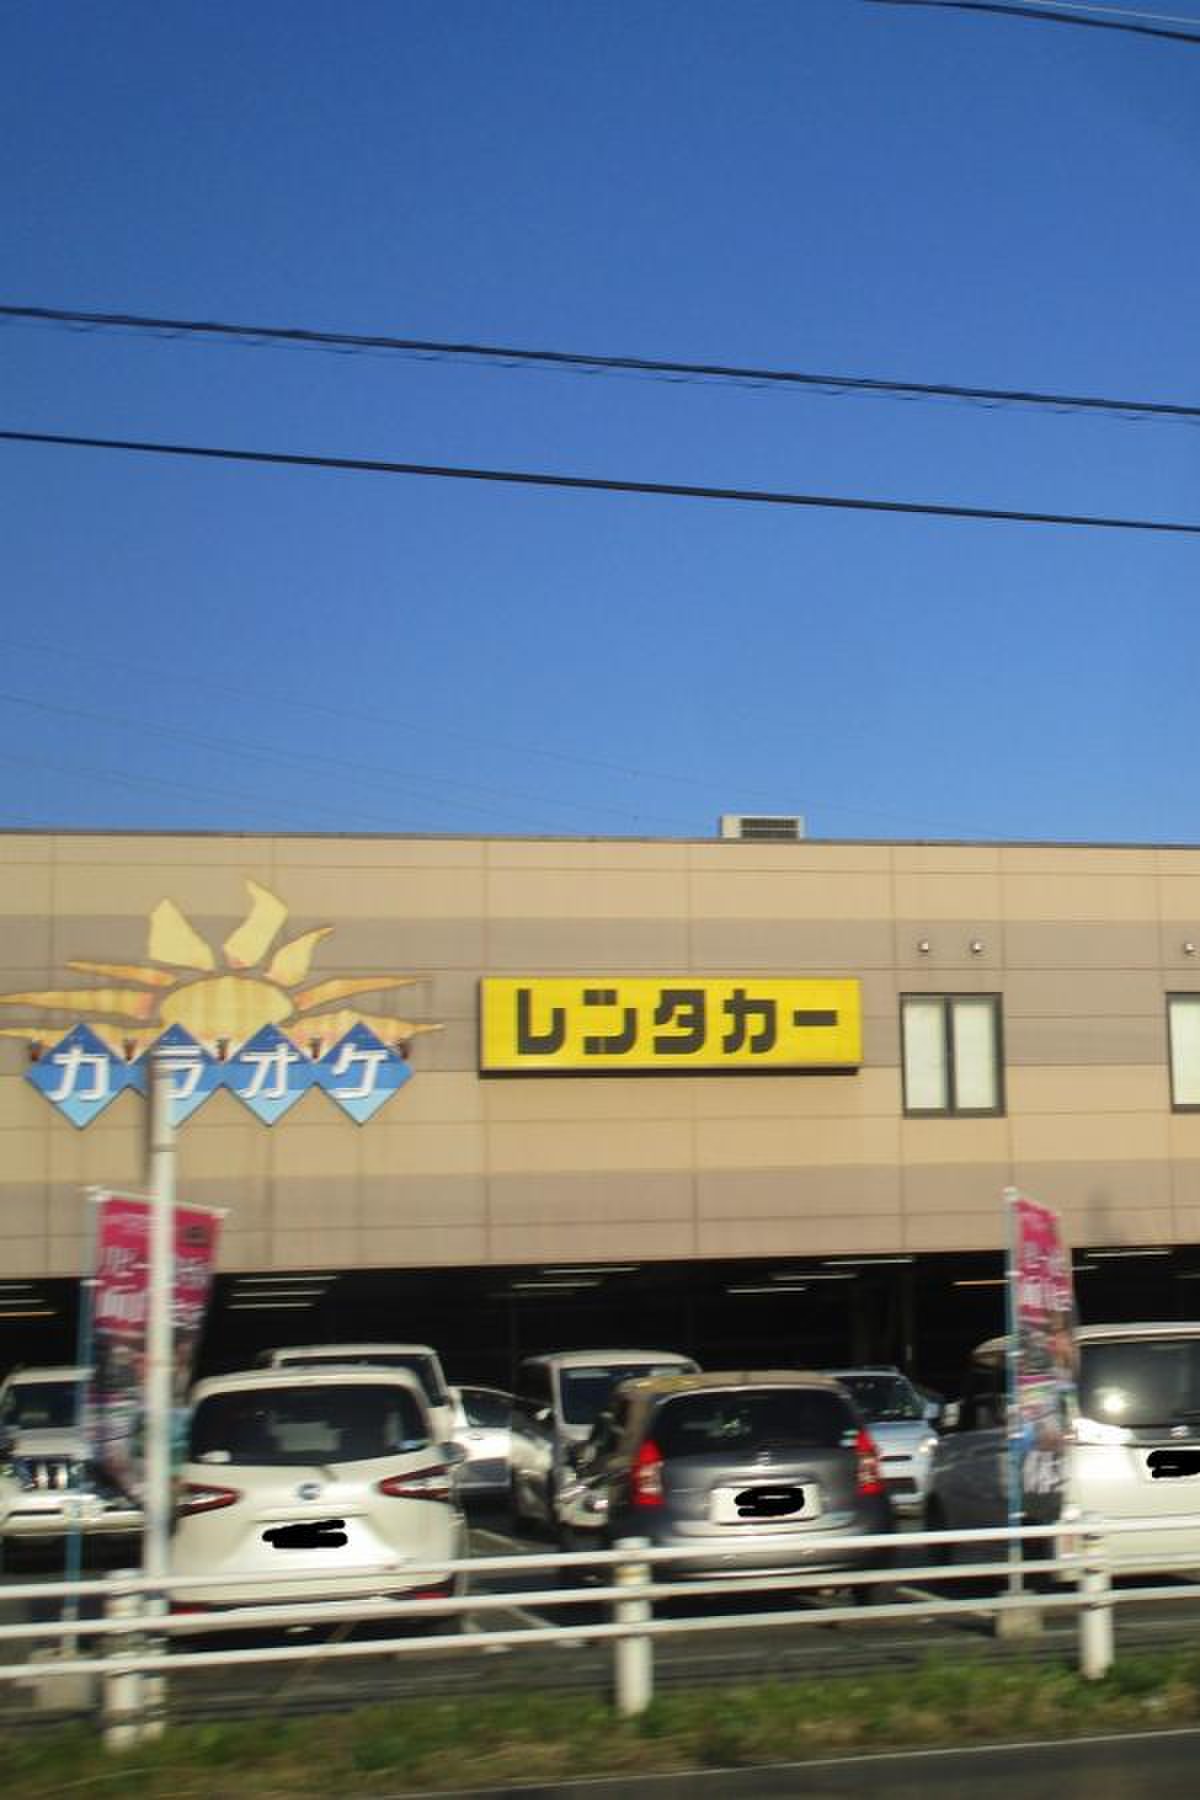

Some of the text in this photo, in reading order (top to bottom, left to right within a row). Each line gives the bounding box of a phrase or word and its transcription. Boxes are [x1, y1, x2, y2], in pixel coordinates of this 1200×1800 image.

[516, 987, 839, 1056] レンタカー
[49, 1043, 389, 1101] カラオケ
